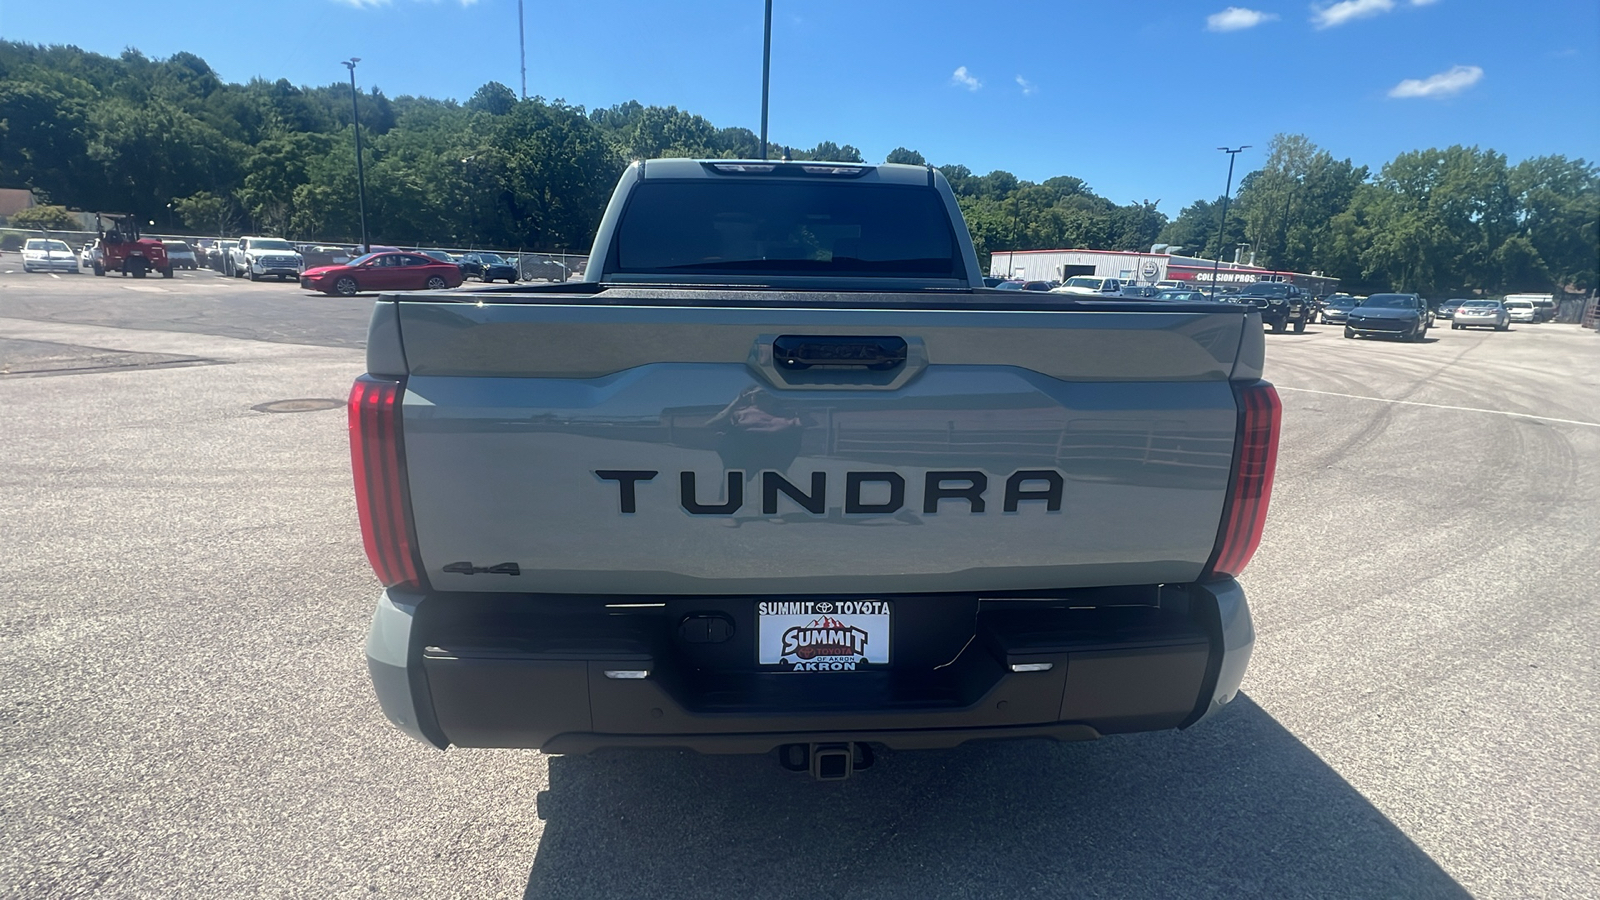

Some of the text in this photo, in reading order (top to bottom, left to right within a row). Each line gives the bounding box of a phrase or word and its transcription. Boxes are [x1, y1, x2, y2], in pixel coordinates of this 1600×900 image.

[1196, 273, 1234, 282] COLLSION
[594, 470, 1064, 515] TUNDRA
[759, 601, 890, 615] SUMMIT TOYOTA
[783, 627, 867, 655] SUMMIT
[792, 662, 856, 671] AKRON
